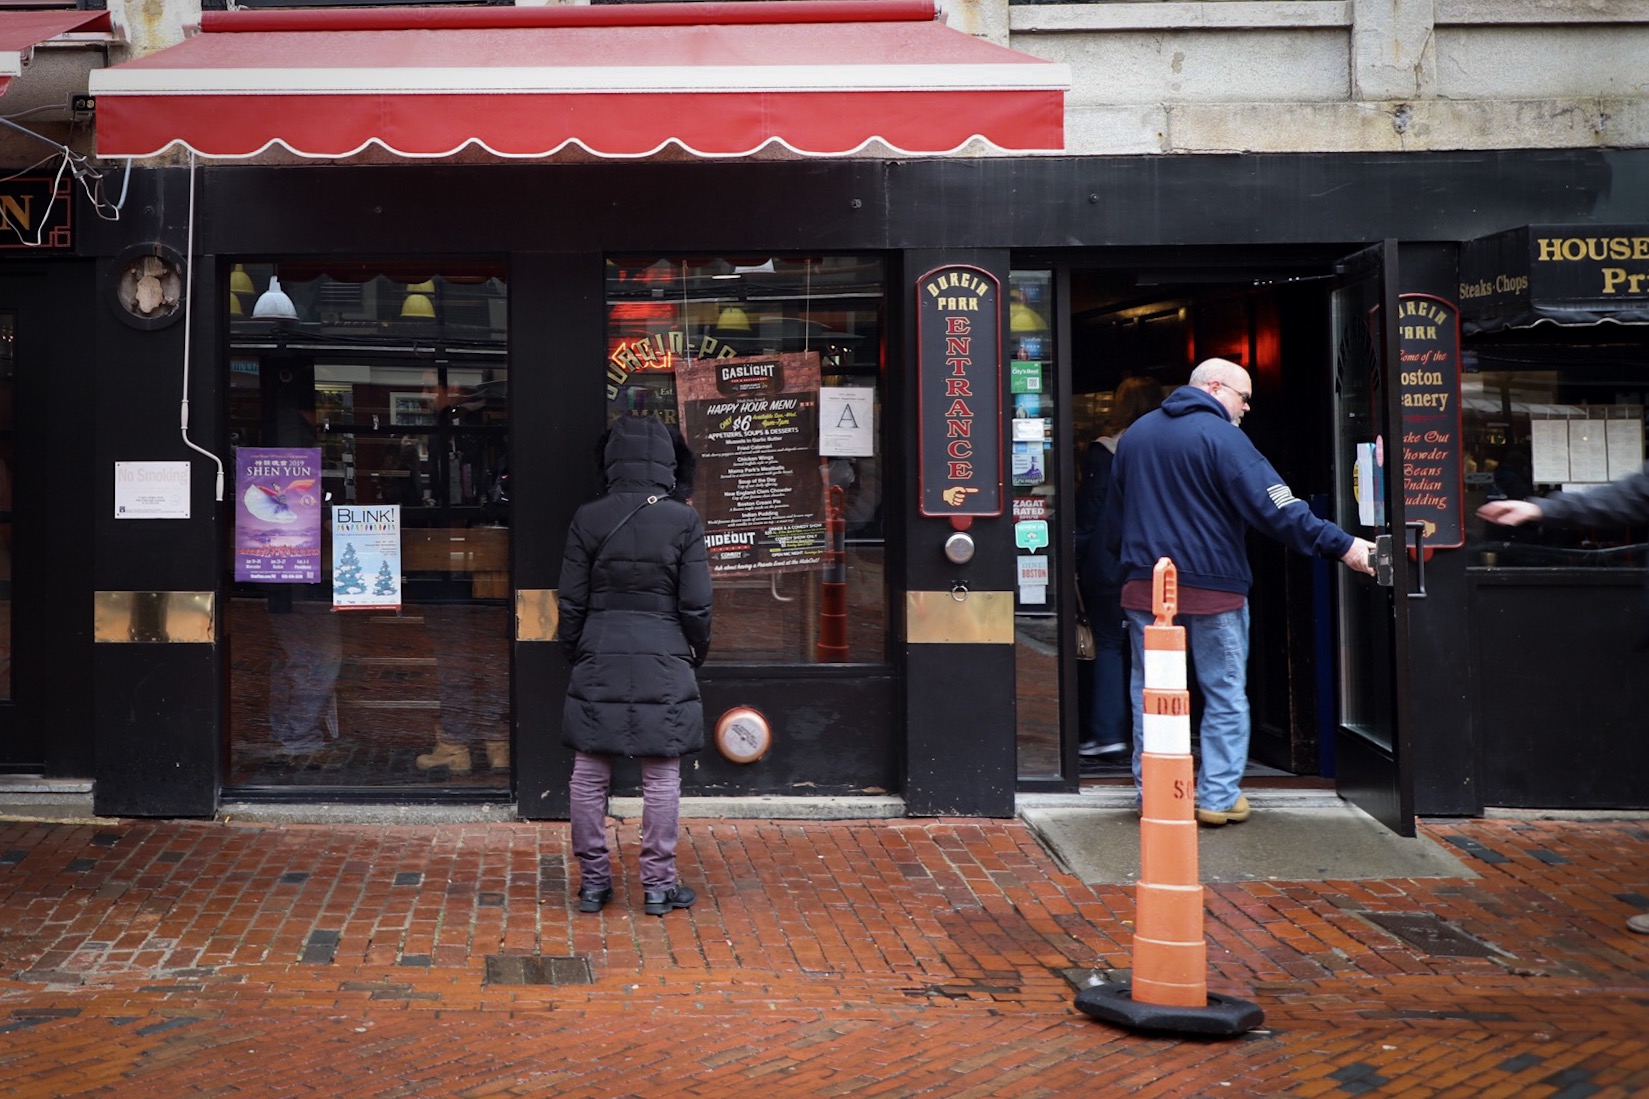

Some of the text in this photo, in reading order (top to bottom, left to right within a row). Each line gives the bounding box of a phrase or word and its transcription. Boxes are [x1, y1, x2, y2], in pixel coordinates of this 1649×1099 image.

[1537, 237, 1649, 261] HOUSE
[927, 272, 989, 298] DURGIN
[1602, 268, 1649, 294] Pr
[938, 297, 979, 311] PARK
[1399, 301, 1448, 326] URGIN
[1400, 326, 1438, 340] ARK
[1420, 350, 1432, 365] of
[1433, 350, 1447, 362] the
[722, 364, 775, 380] GASLIGHT
[1401, 368, 1442, 386] oston
[945, 316, 974, 480] ENTRANCE
[707, 402, 739, 416] HAPPY
[740, 401, 767, 412] HOUR
[769, 398, 798, 410] MENU
[719, 414, 752, 432] ONLY $6
[836, 404, 860, 428] A
[743, 430, 764, 438] SOUPS
[770, 427, 800, 435] DESSERTS
[1402, 432, 1421, 443] ake
[1403, 448, 1448, 460] howder
[118, 468, 188, 486] No Smoking
[247, 467, 311, 476] SHEN YUN
[1405, 493, 1448, 510] udding
[338, 508, 395, 523] BLINK!
[704, 532, 756, 548] HIDEOUT
[1022, 569, 1046, 578] BOSTON
